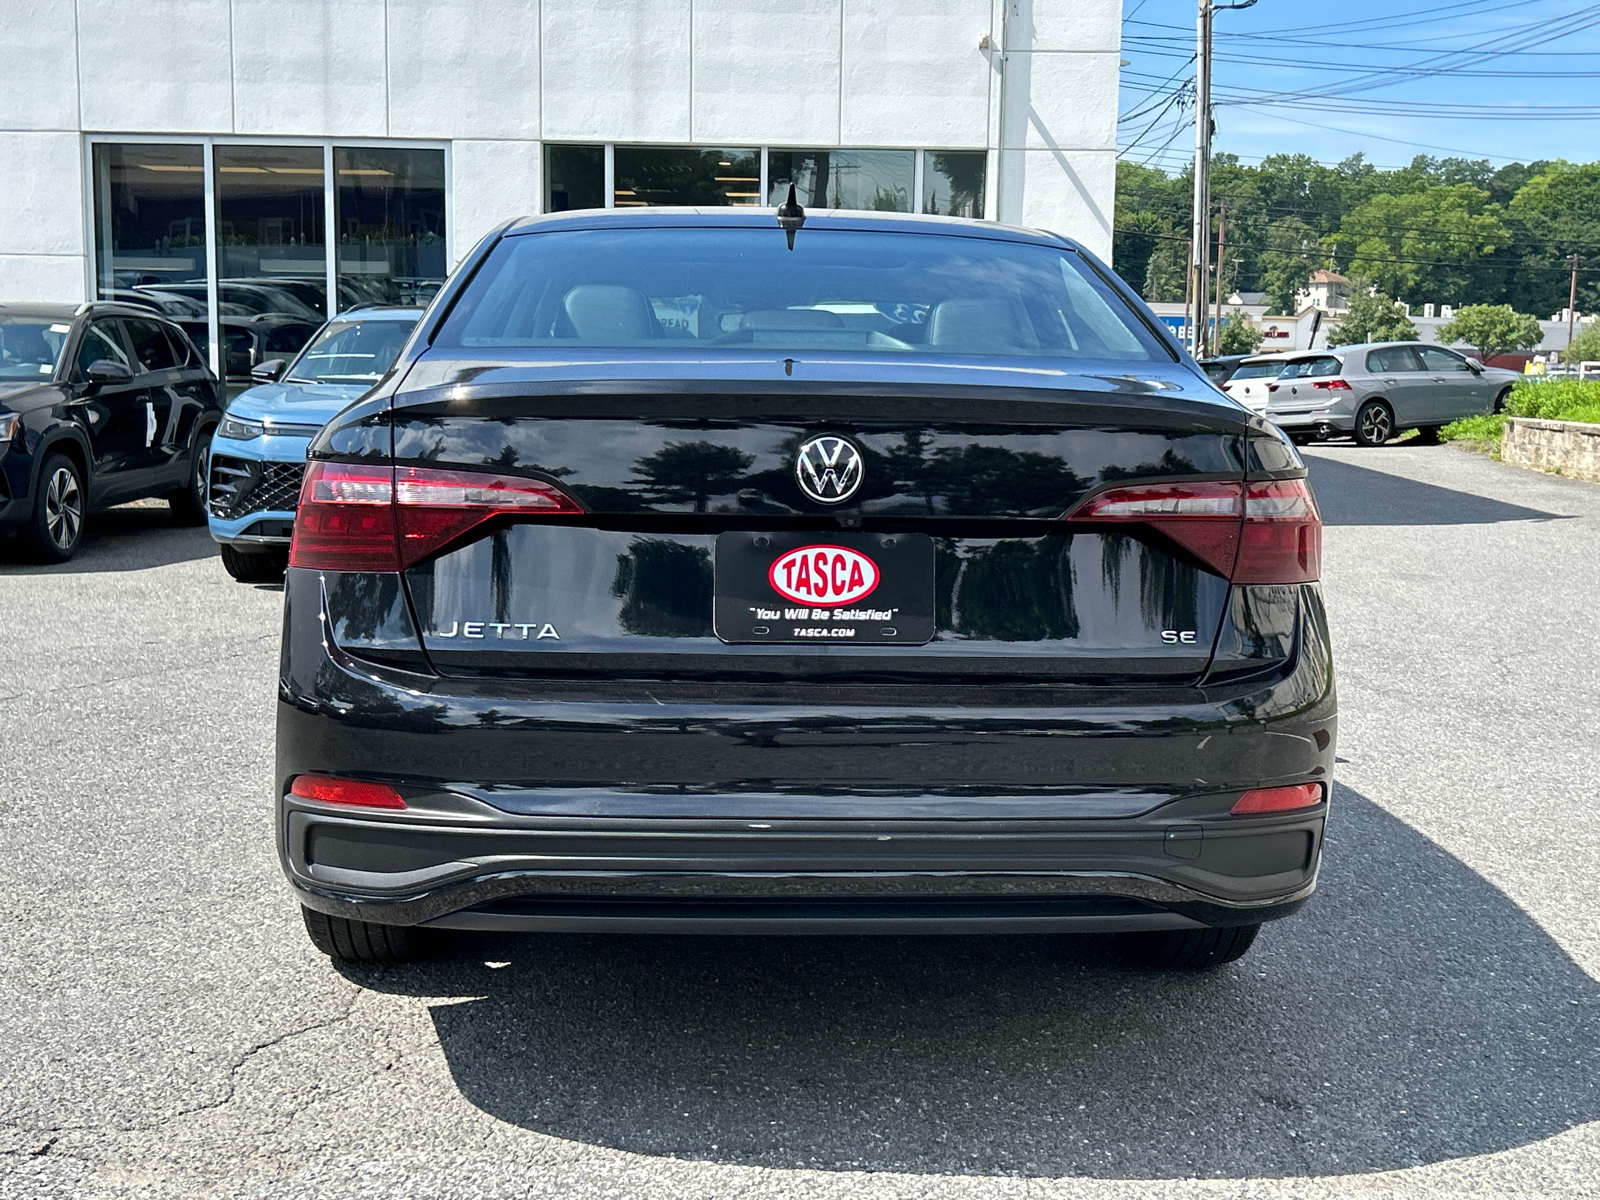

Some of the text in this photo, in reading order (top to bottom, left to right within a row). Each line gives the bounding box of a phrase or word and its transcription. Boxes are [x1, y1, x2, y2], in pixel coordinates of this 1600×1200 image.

[782, 552, 865, 598] TASCA
[784, 608, 809, 620] Will
[811, 608, 830, 620] Be
[439, 621, 560, 640] JETTA
[793, 628, 856, 637] TASCA.COM
[1160, 630, 1197, 644] SE
